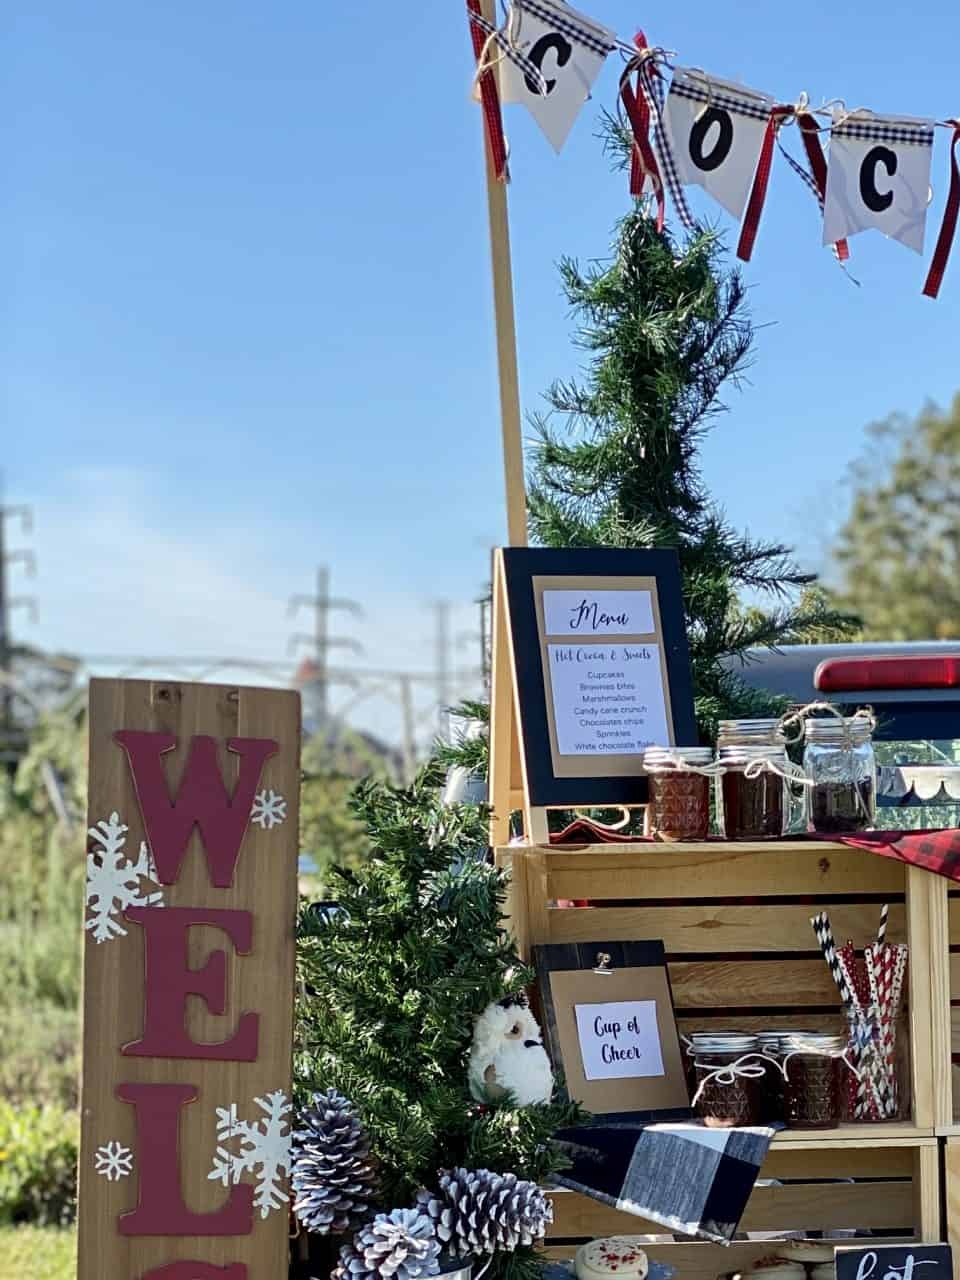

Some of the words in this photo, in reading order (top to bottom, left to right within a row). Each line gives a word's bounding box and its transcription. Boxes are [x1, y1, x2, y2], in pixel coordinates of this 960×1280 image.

[569, 600, 629, 630] Menu
[555, 648, 572, 662] Hot
[587, 671, 625, 680] Cupcakes
[574, 707, 598, 716] Candy
[574, 743, 597, 751] White
[594, 1015, 621, 1040] Cup
[627, 1015, 640, 1034] of
[601, 1044, 641, 1064] Cheer
